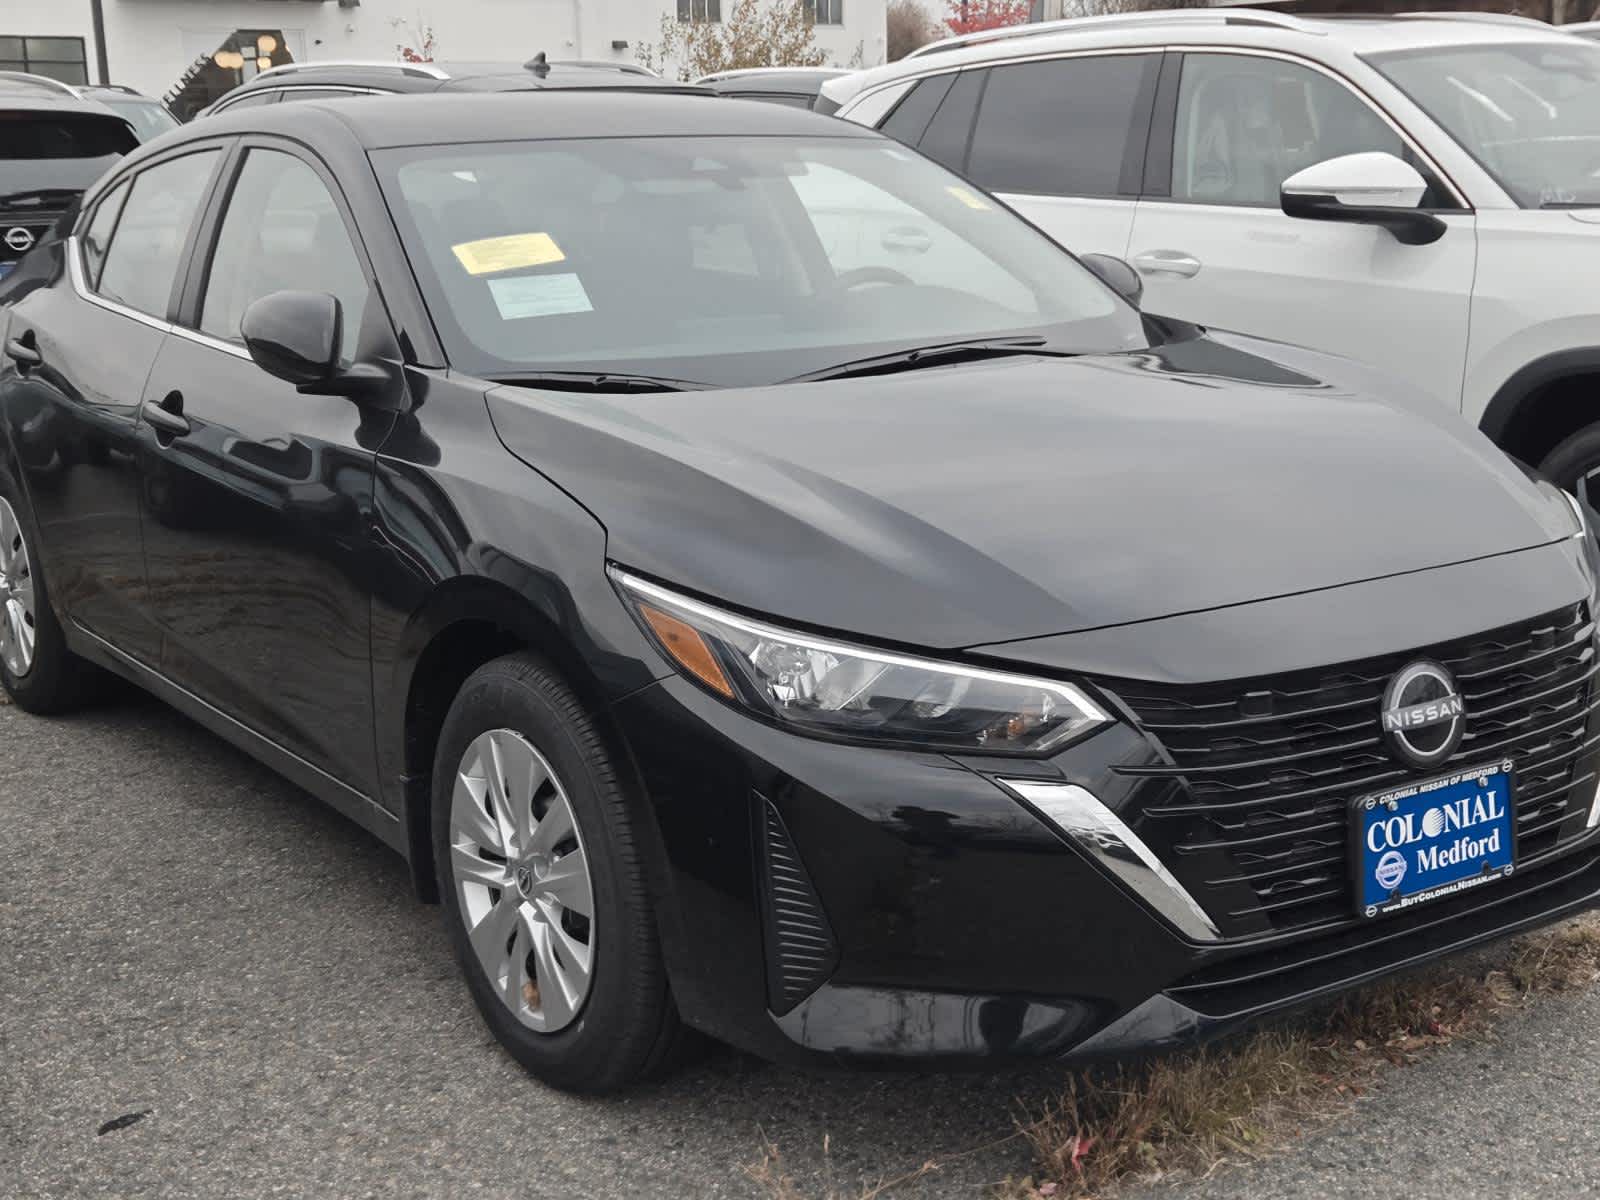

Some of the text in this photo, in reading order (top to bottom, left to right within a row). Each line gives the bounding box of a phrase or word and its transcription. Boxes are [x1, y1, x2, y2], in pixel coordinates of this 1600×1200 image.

[161, 53, 211, 107] ELLNESS
[1387, 697, 1462, 729] NISSAN
[1379, 766, 1499, 805] COLONIAL NISSAN OF MEDFORD
[1367, 790, 1505, 853] COLONIAL
[1417, 828, 1501, 874] Medford
